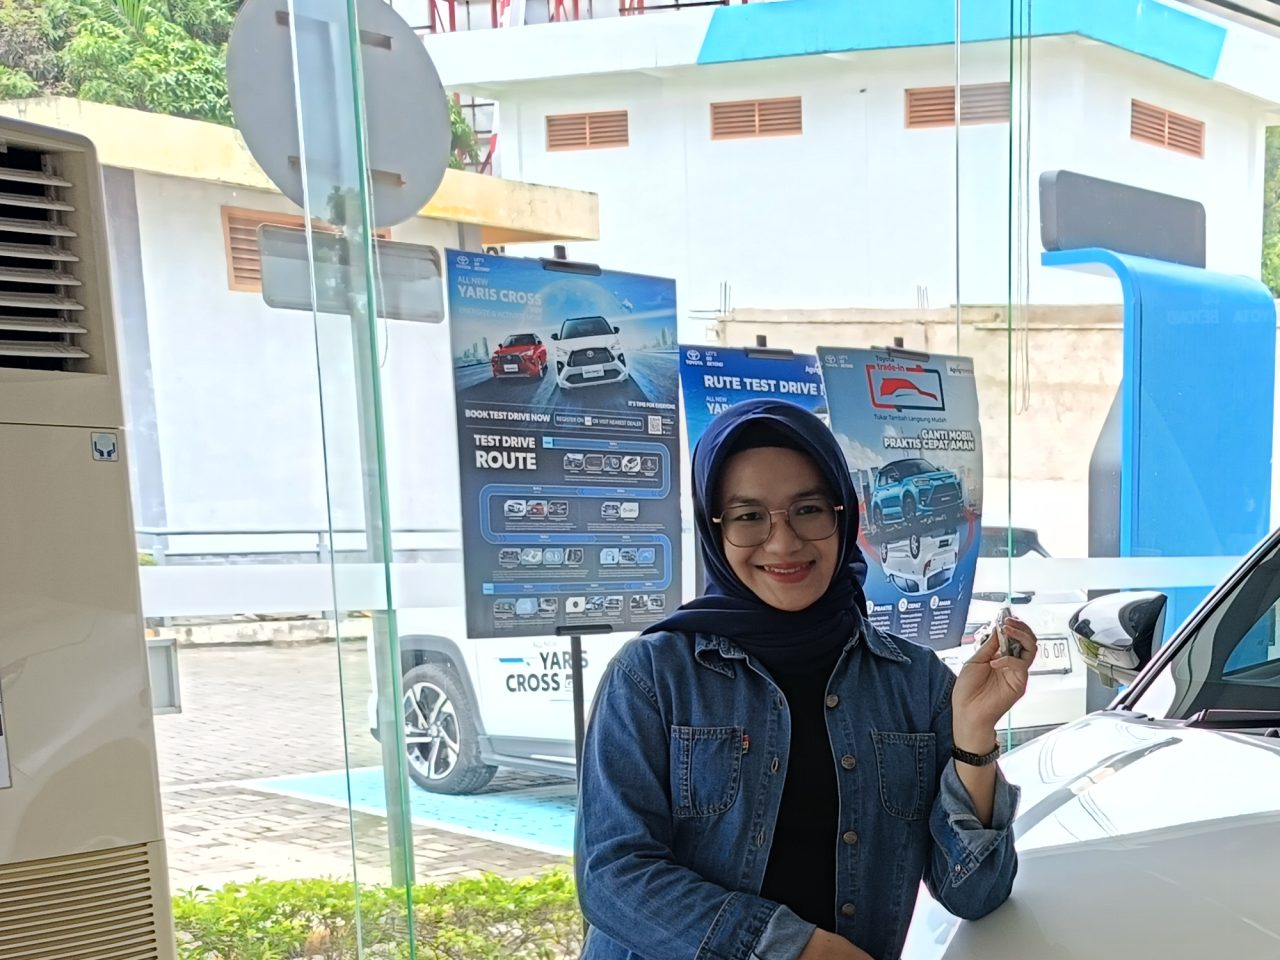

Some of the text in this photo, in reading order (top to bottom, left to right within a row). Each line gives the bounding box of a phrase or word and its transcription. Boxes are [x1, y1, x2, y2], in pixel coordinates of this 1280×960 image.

[457, 285, 543, 306] YARIS CROSS
[876, 363, 907, 372] trade-in
[704, 375, 742, 390] RUTE
[743, 378, 777, 392] TEST
[779, 381, 818, 396] DRIVE
[465, 409, 550, 423] BOOK TEST DRIVE NOW
[473, 434, 536, 448] TEST DRIVE
[921, 429, 974, 441] GANTI MOBIL
[884, 438, 975, 451] PRAKTIS CEPAT AMAN
[475, 450, 537, 470] ROUTE
[540, 651, 589, 670] YARS
[506, 672, 560, 693] CROSS
